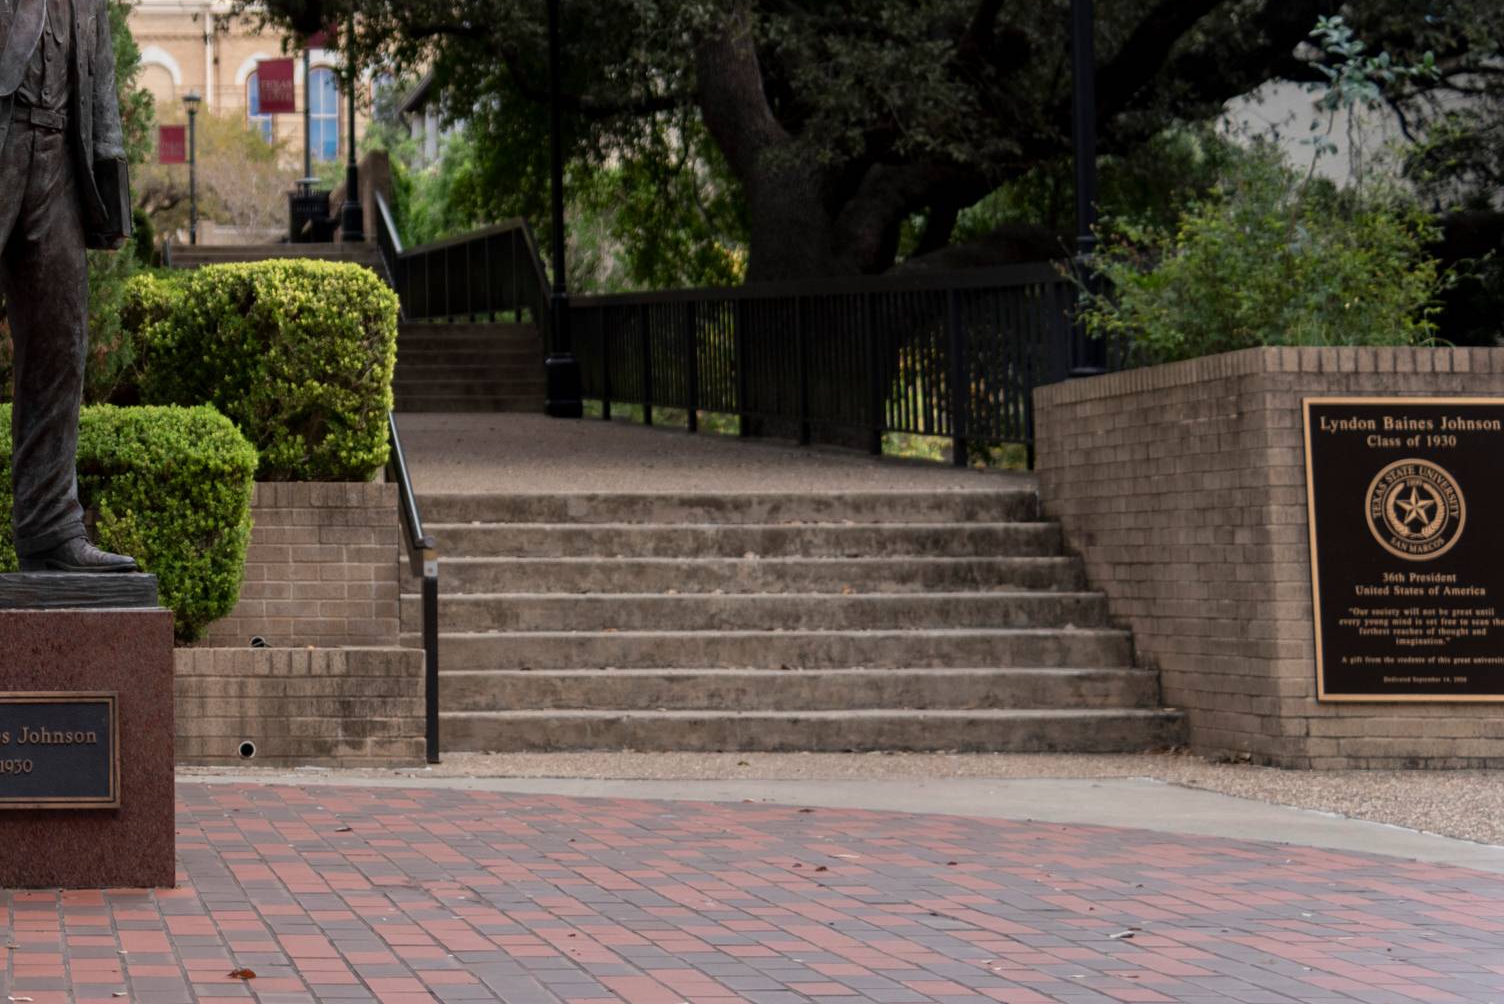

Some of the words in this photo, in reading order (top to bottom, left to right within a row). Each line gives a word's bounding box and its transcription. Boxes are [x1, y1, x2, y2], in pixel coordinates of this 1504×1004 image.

[1320, 416, 1377, 434] Lyndon
[1383, 416, 1434, 431] Baines
[1440, 416, 1501, 431] Johnson
[1367, 434, 1401, 447] Class
[1406, 434, 1422, 447] of
[1426, 434, 1457, 447] 1930
[1372, 481, 1387, 518] TEXAS
[1386, 466, 1416, 482] STATE
[1419, 465, 1460, 518] UNIVERSITY
[1390, 537, 1408, 552] SAN
[1410, 537, 1445, 554] MARCOS
[1382, 572, 1405, 583] 36th
[1409, 572, 1456, 583] President
[1355, 585, 1389, 596] United
[1393, 585, 1424, 596] States
[1428, 585, 1439, 596] of
[1443, 585, 1486, 596] America
[1372, 608, 1399, 617] society
[1403, 608, 1420, 616] will
[1422, 608, 1436, 616] not
[1438, 608, 1448, 616] be
[1451, 608, 1472, 618] great
[1475, 607, 1495, 616] until
[1339, 618, 1360, 627] every
[1364, 618, 1389, 627] young
[1392, 618, 1412, 626] mind
[1415, 618, 1423, 626] is
[1426, 618, 1438, 626] set
[1440, 618, 1456, 626] free
[1459, 618, 1469, 626] to
[1471, 618, 1489, 626] scan
[1359, 628, 1390, 636] farthest
[1393, 628, 1423, 636] reaches
[1426, 628, 1435, 636] of
[1438, 628, 1469, 637] thought
[1472, 628, 1487, 636] and
[17, 726, 97, 744] Johnson
[0, 759, 33, 774] 1930
